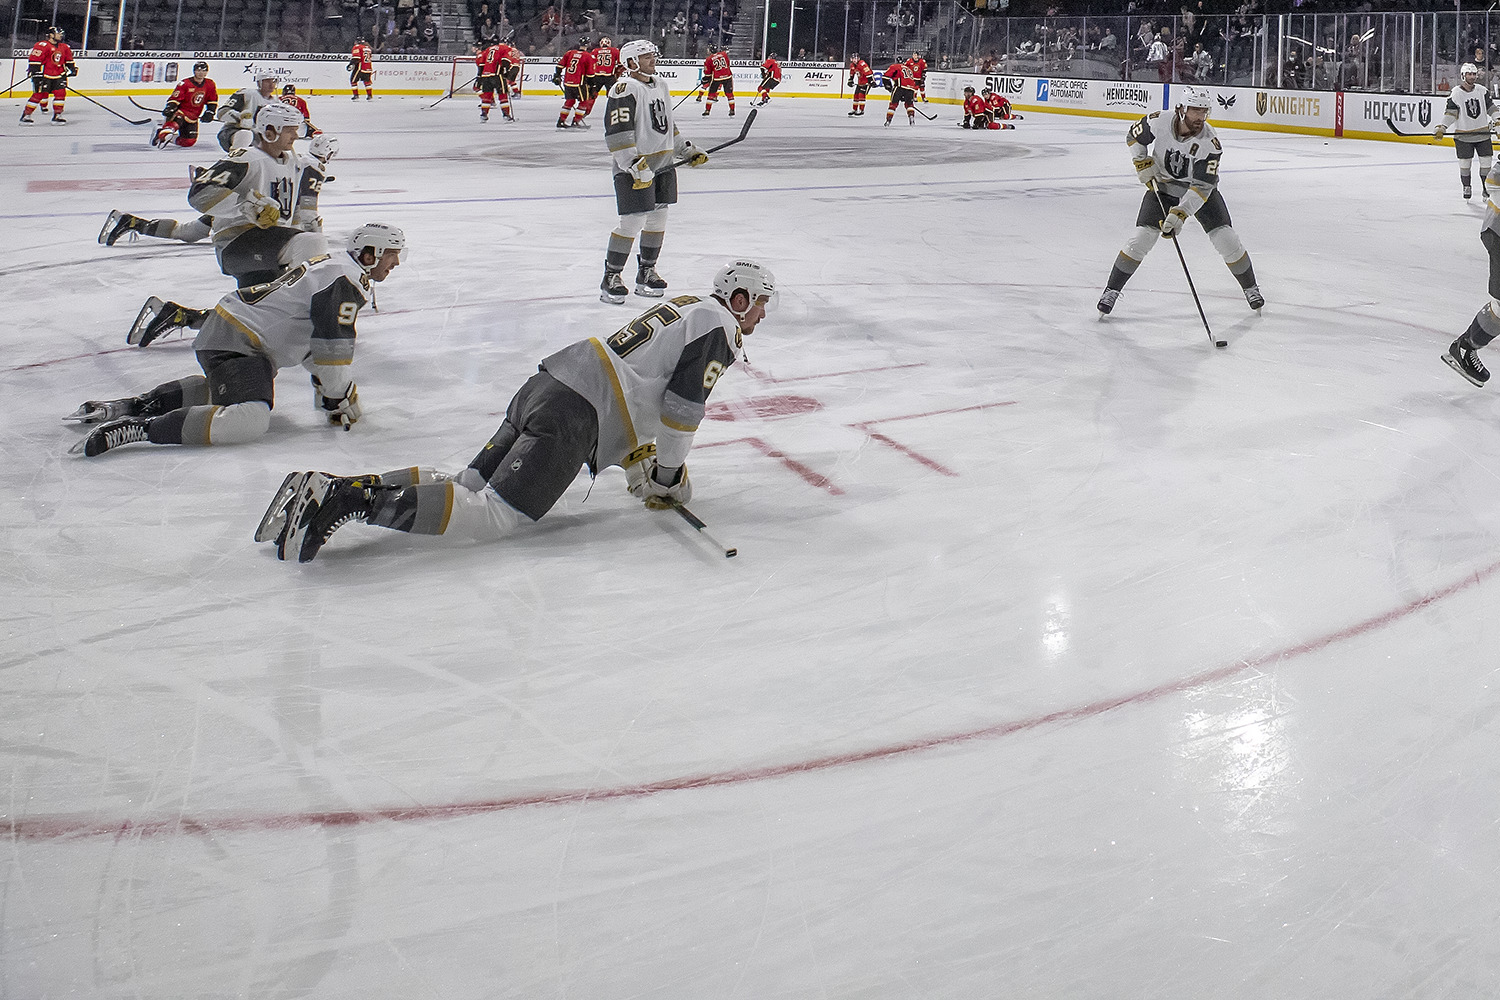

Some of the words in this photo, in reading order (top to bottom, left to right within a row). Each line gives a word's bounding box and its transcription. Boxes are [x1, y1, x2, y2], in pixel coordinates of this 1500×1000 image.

[96, 50, 181, 59] dontbebroke.com
[193, 51, 224, 59] DOLLAR
[288, 53, 351, 62] dontbebroke.
[379, 54, 409, 62] DOLLAR
[597, 54, 612, 67] 35
[105, 63, 125, 72] LONG
[567, 59, 578, 74] 3
[102, 72, 126, 81] DRINK
[985, 76, 1010, 94] SMI
[1049, 79, 1069, 90] PACIFIC
[1070, 81, 1088, 90] OFFICE
[1049, 88, 1084, 99] AUTOMATION
[1106, 87, 1149, 103] HENDERSON
[1269, 95, 1321, 117] KNIGHTS
[1363, 100, 1417, 123] HOCKEY
[609, 108, 631, 126] 25
[196, 169, 232, 185] 44
[606, 304, 682, 359] 5
